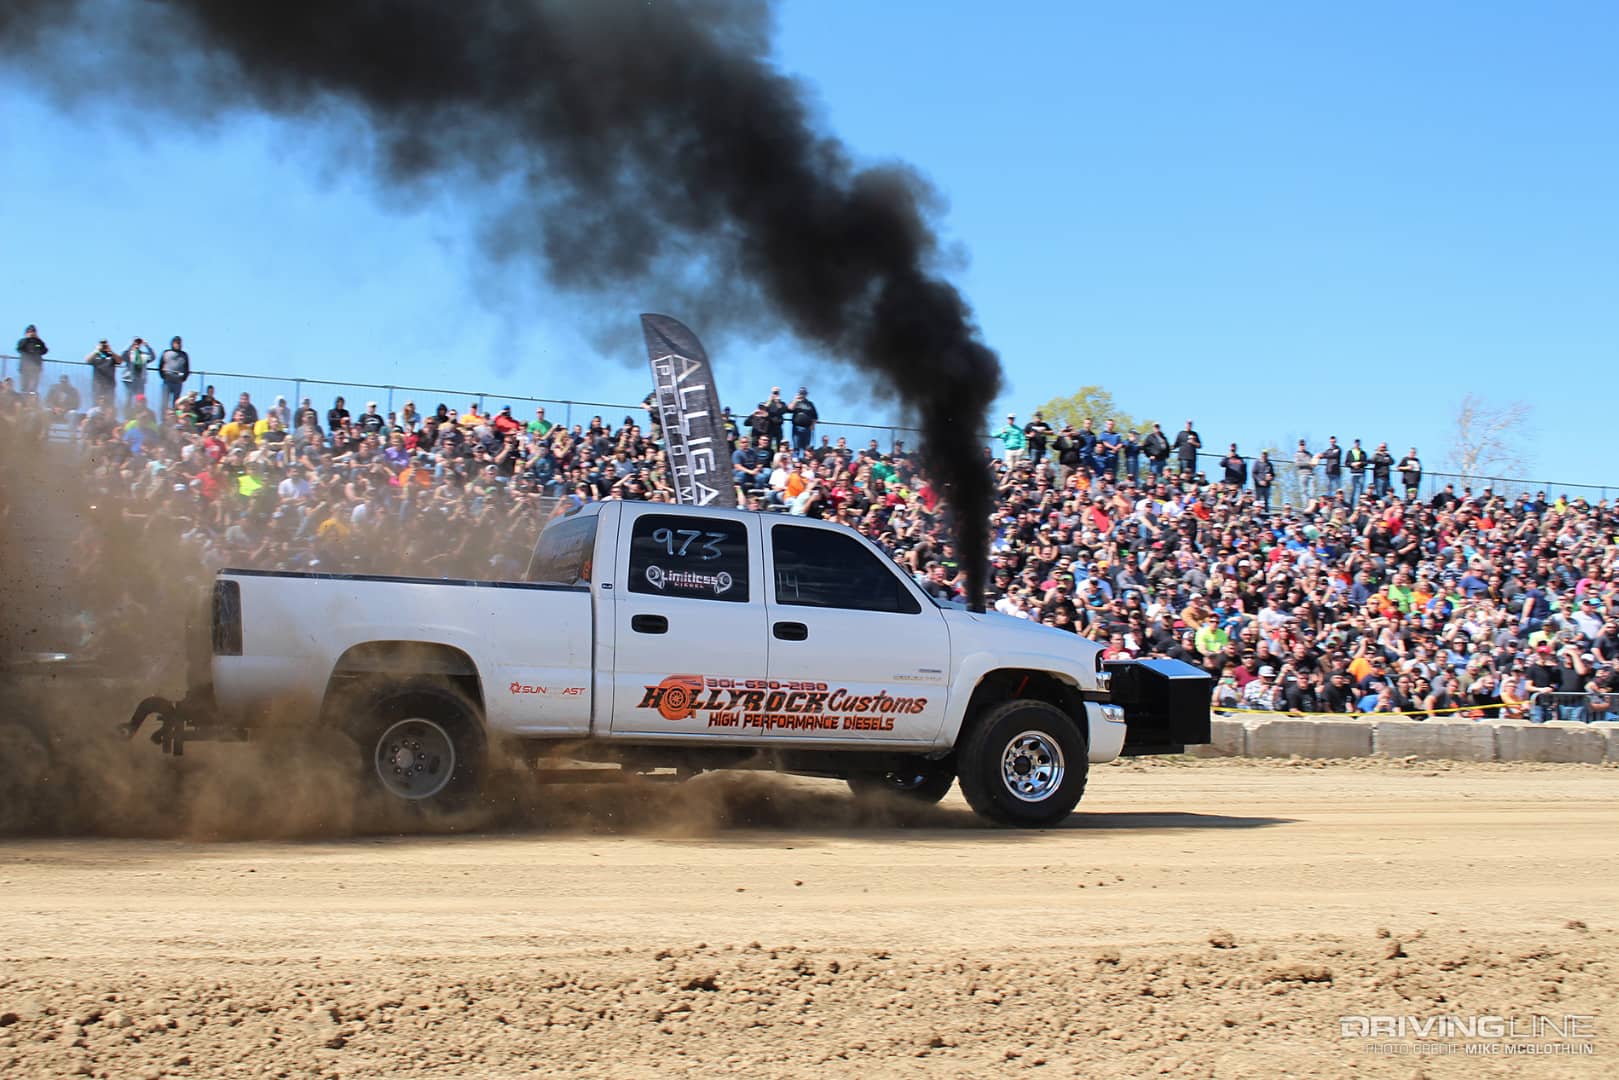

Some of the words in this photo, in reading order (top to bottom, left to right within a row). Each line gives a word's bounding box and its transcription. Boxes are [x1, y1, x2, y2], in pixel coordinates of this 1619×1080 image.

[652, 528, 728, 560] 973
[660, 570, 720, 585] Limitless
[827, 688, 928, 714] Customs
[707, 709, 741, 728] HIGH
[742, 712, 840, 732] PERFORMANCE
[841, 713, 896, 731] DIESELS
